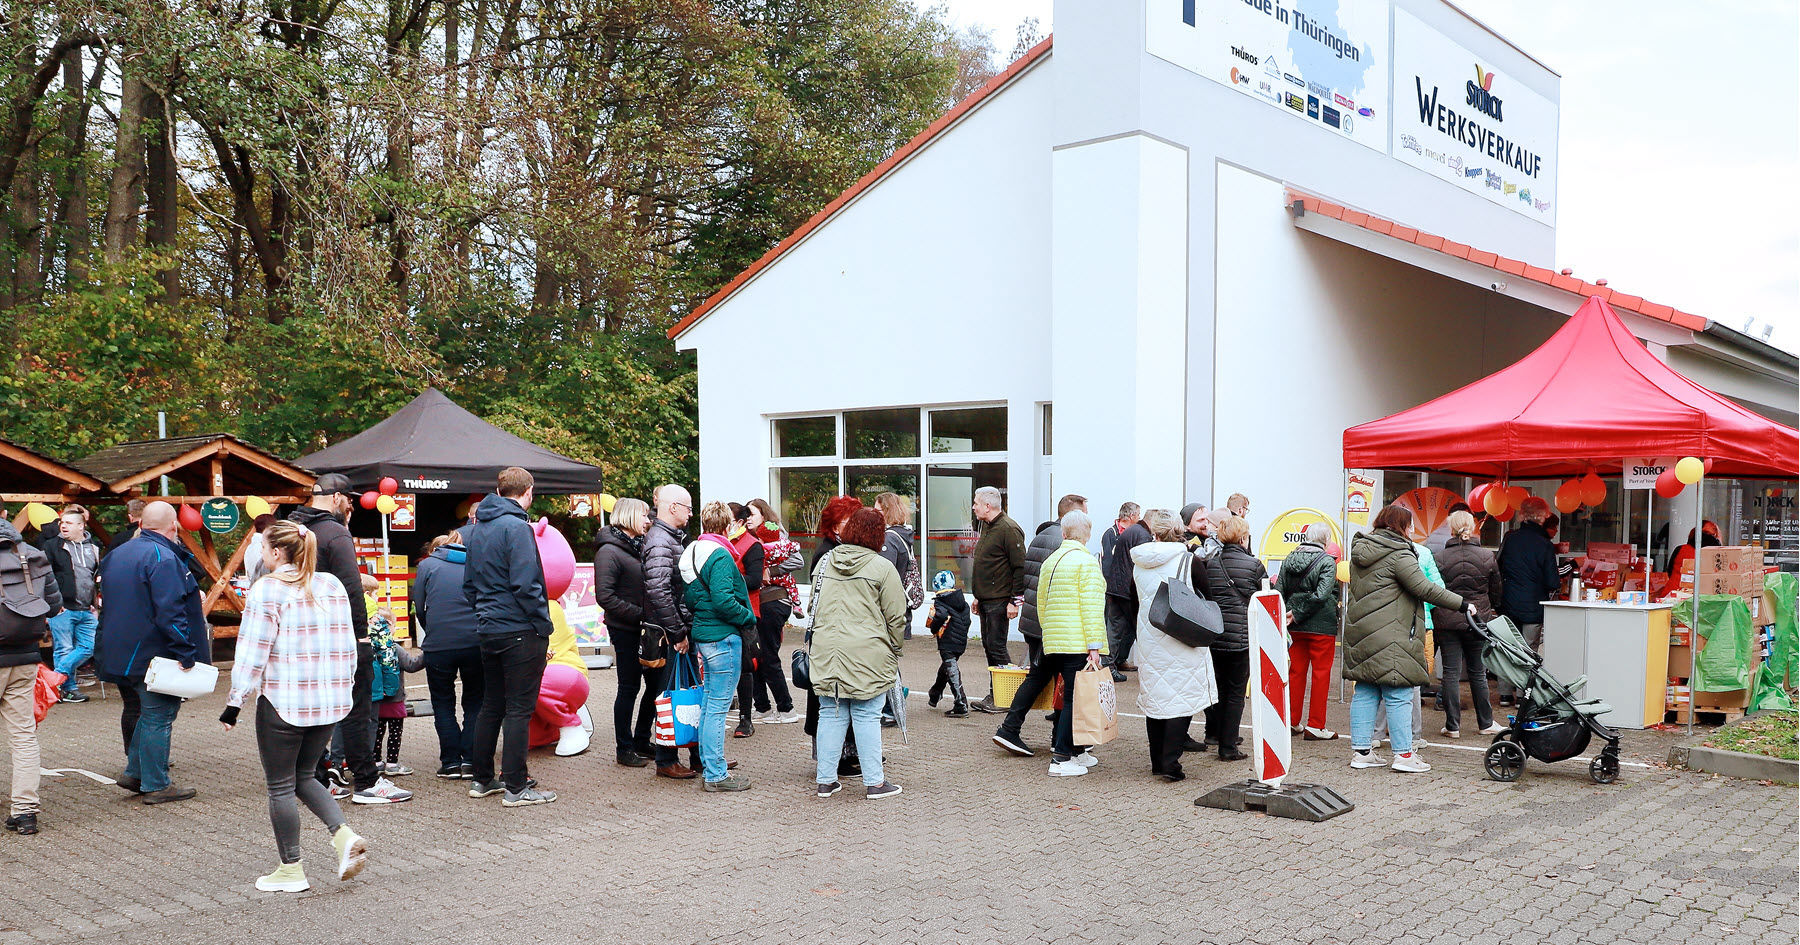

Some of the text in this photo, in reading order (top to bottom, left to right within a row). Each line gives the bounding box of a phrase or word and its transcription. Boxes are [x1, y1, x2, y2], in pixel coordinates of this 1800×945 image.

[1276, 0, 1289, 25] in
[1292, 9, 1360, 62] Thüringen
[1466, 79, 1503, 122] STORCK
[1425, 148, 1446, 164] merci
[1283, 531, 1307, 543] STOR
[959, 541, 977, 559] Caf
